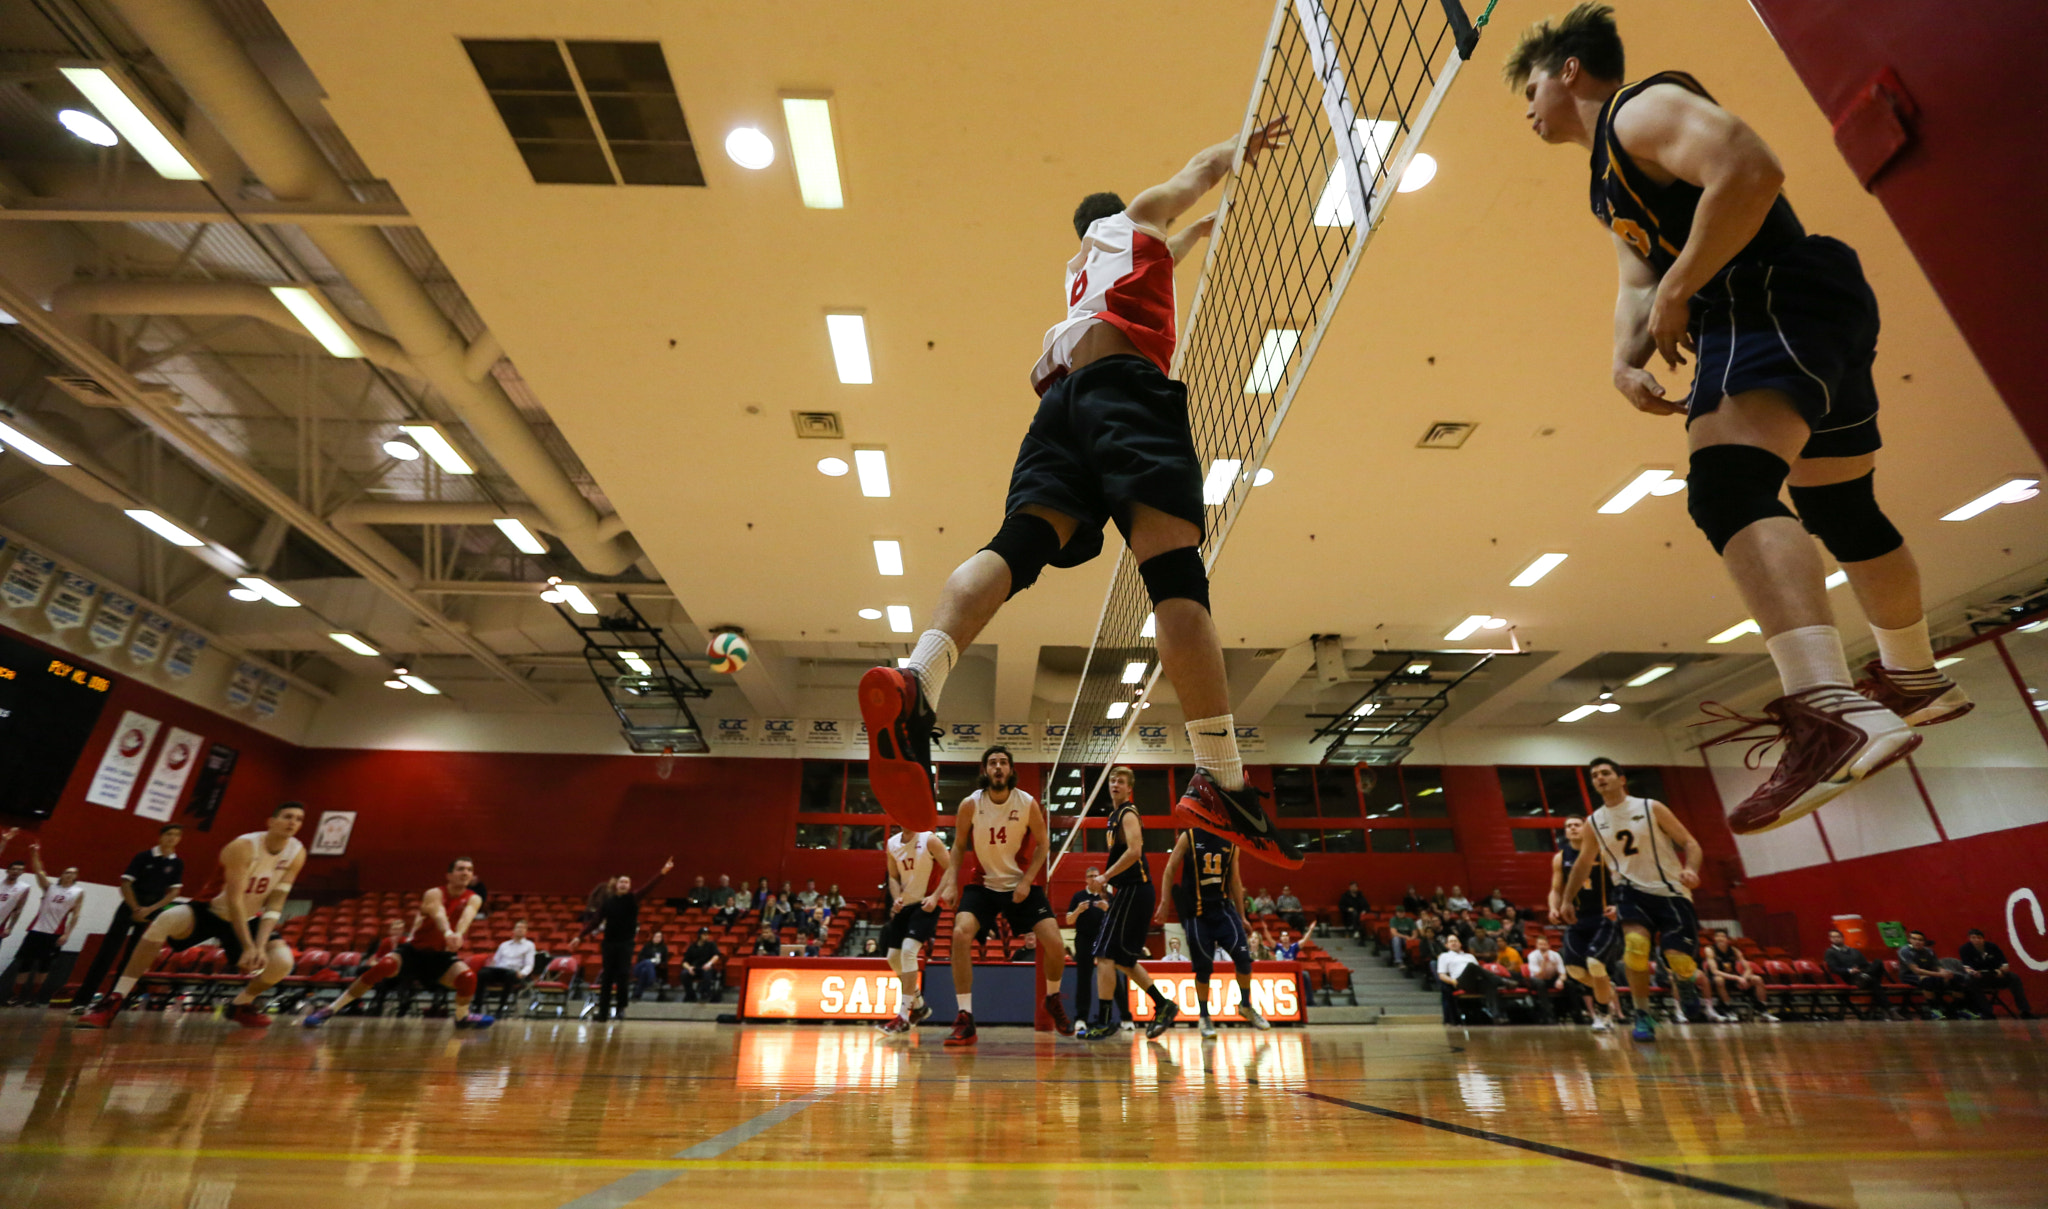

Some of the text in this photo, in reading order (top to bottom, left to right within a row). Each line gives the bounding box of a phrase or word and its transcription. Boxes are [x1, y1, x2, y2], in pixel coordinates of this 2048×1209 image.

[989, 826, 1007, 845] 14
[1615, 829, 1639, 857] 2
[902, 857, 914, 871] 17
[1202, 852, 1222, 875] 11
[245, 876, 270, 894] 18
[820, 975, 903, 1014] SAIT
